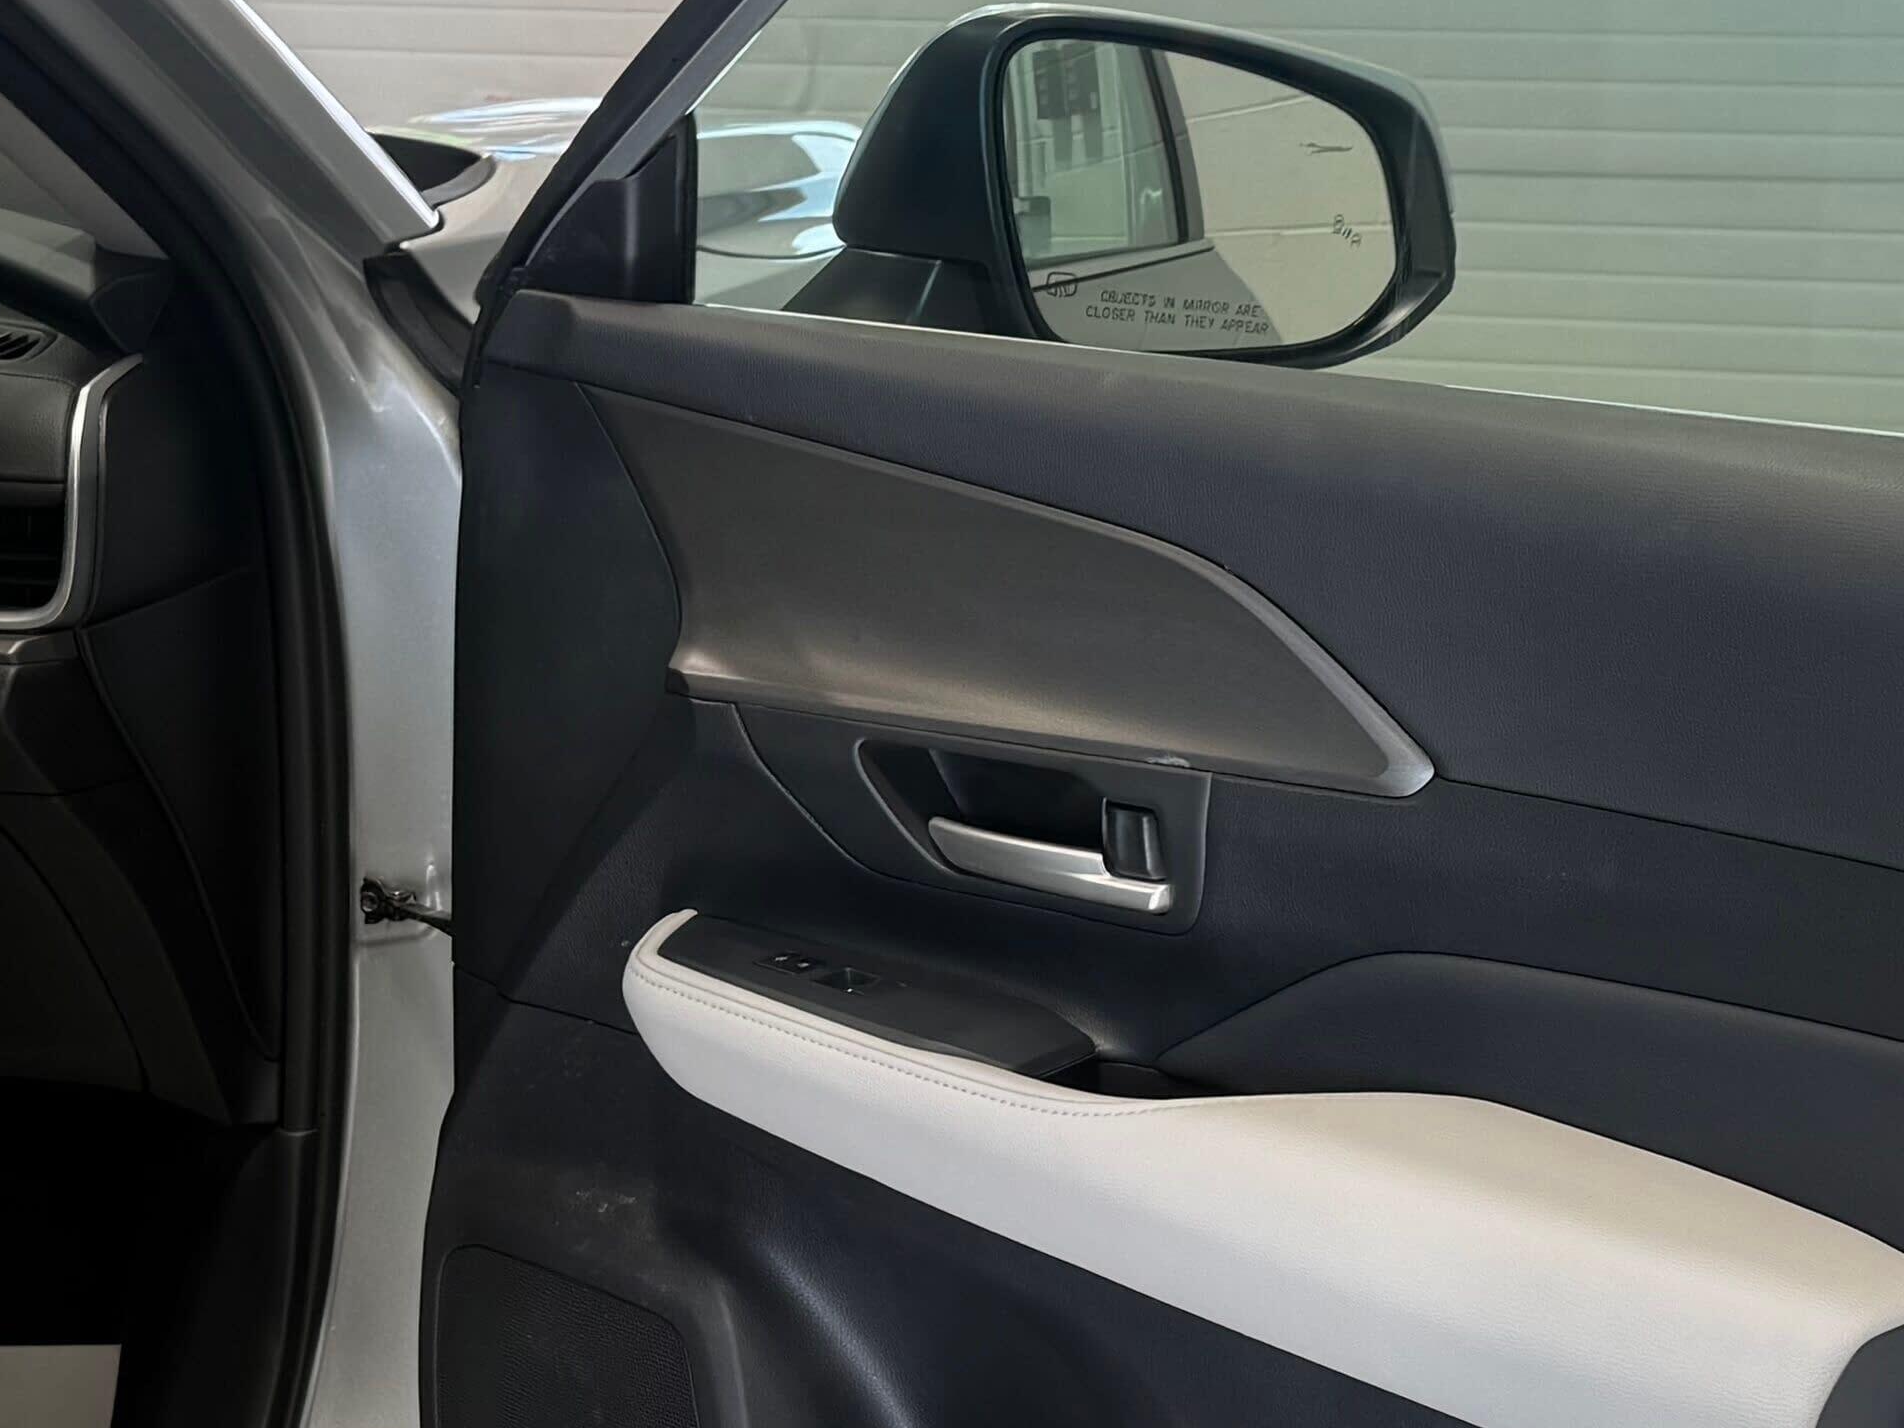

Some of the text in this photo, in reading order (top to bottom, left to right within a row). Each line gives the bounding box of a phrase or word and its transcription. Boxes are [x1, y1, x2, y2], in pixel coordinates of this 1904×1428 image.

[1100, 289, 1263, 318] OBJECTS IN MIRROR ARE
[1085, 304, 1270, 334] CLOSER THAN THEY APPEAR
